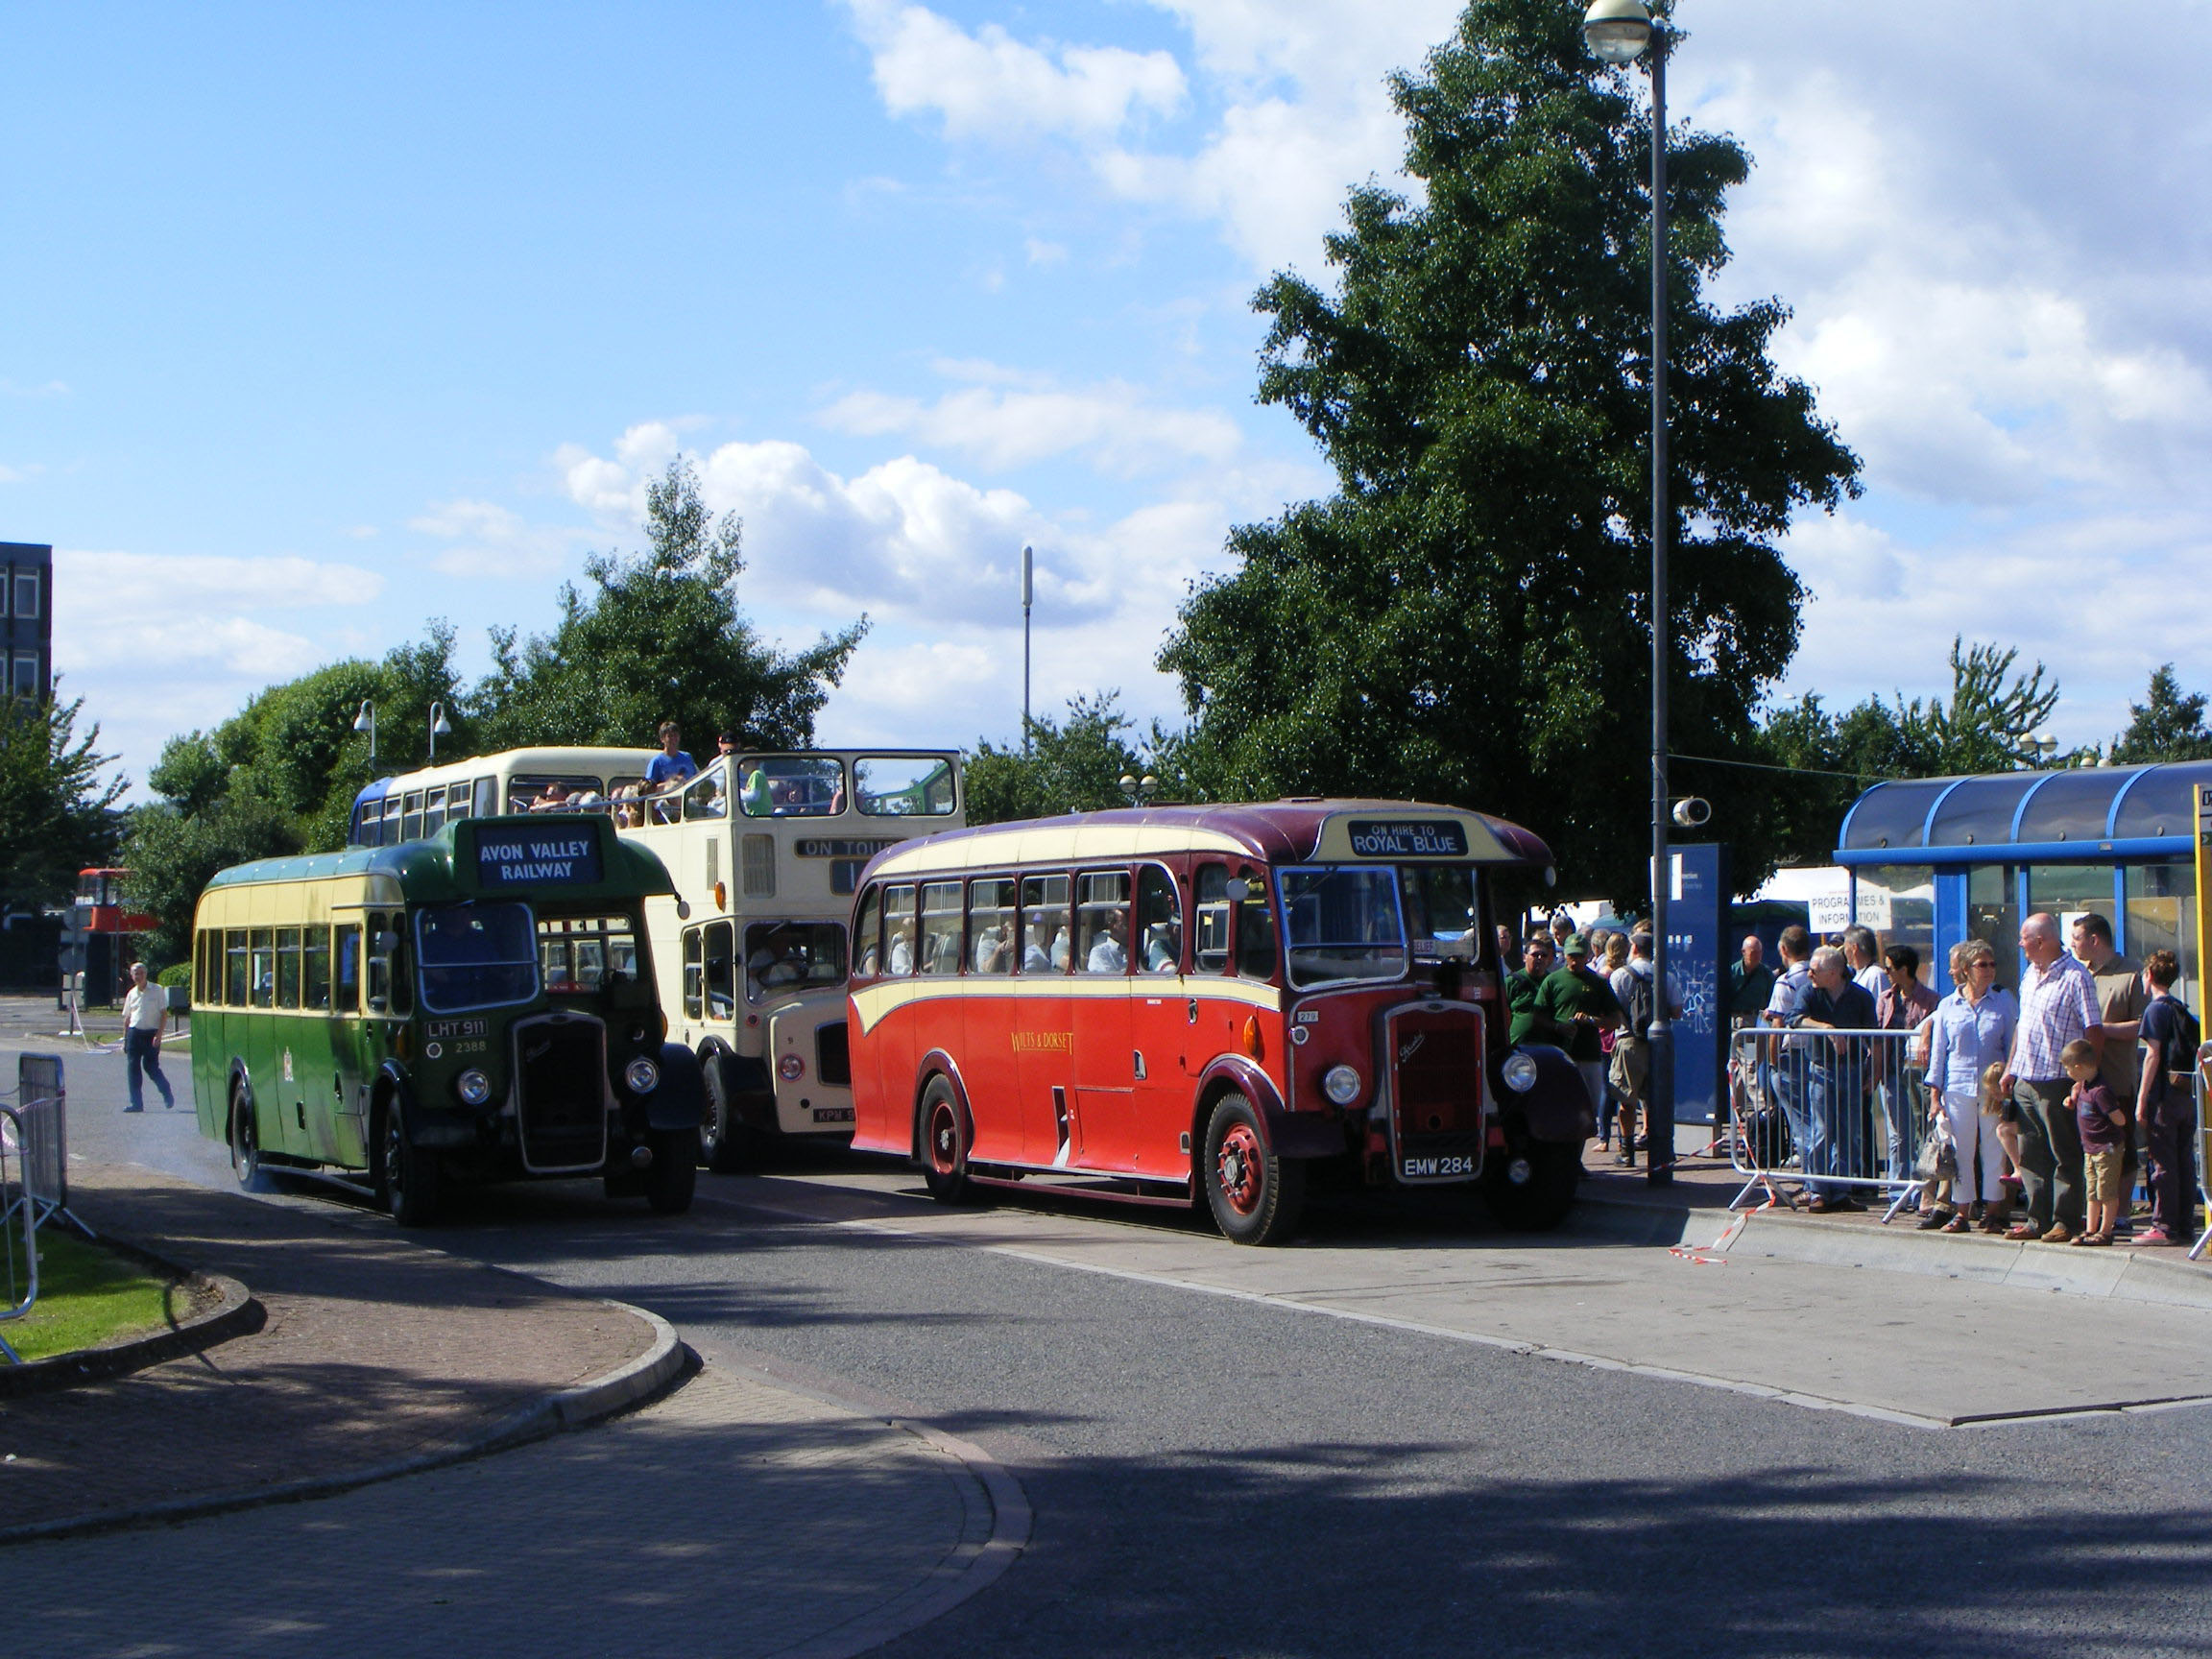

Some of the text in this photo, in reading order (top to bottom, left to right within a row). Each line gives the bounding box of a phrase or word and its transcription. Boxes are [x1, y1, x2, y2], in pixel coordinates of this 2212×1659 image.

[1371, 825, 1435, 836] ON HIRE TO
[480, 840, 589, 862] AVON VALLEY
[805, 841, 832, 855] ON
[1353, 835, 1458, 852] ROYAL BLUE
[501, 861, 573, 880] RAILWAY
[1812, 895, 1885, 908] PROGRAMES &
[1818, 911, 1880, 925] INFORTION
[428, 1020, 485, 1037] LHT 911
[455, 1041, 487, 1054] 2388
[1011, 1032, 1074, 1055] WILTS & DORSET
[1405, 1156, 1474, 1176] EMW 284
